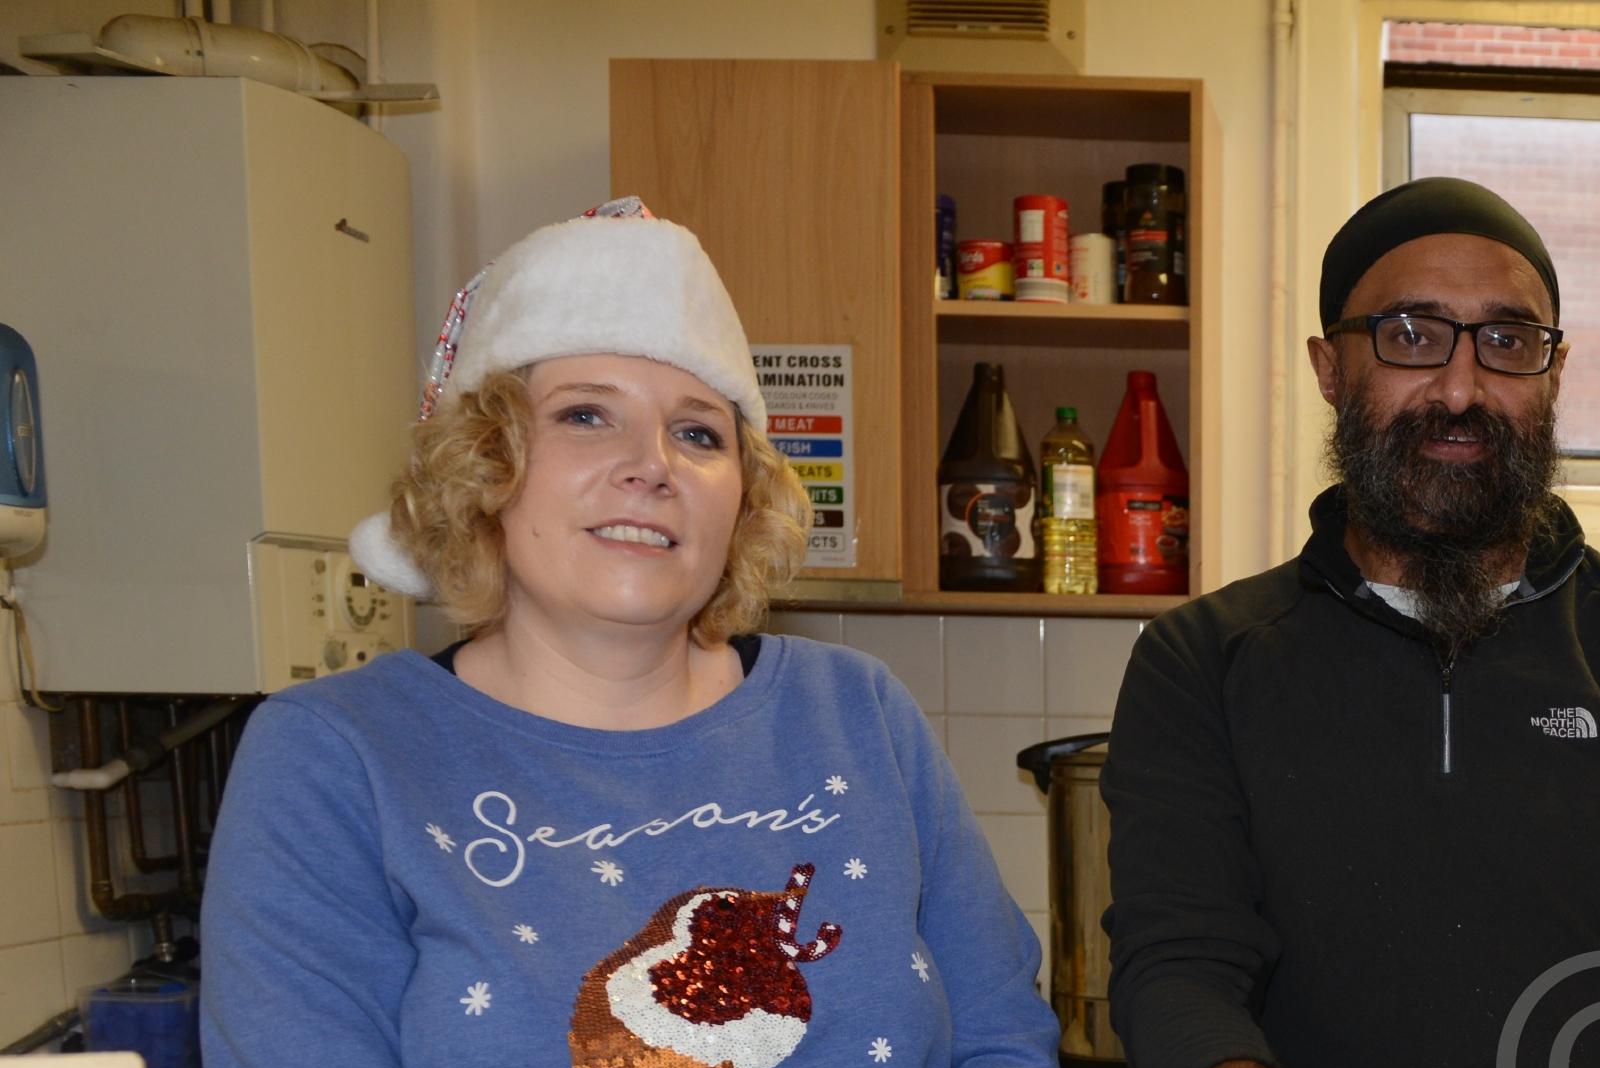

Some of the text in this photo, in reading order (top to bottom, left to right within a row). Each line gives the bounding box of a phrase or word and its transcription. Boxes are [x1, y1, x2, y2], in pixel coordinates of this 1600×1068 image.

[752, 355, 842, 368] ENT CROSS
[775, 418, 815, 431] MEAT
[779, 442, 811, 455] FISH
[793, 466, 833, 478] EATS
[1549, 707, 1575, 718] THE
[1530, 717, 1576, 729] NORTH
[1543, 727, 1576, 738] FACE
[464, 791, 841, 887] Season's
